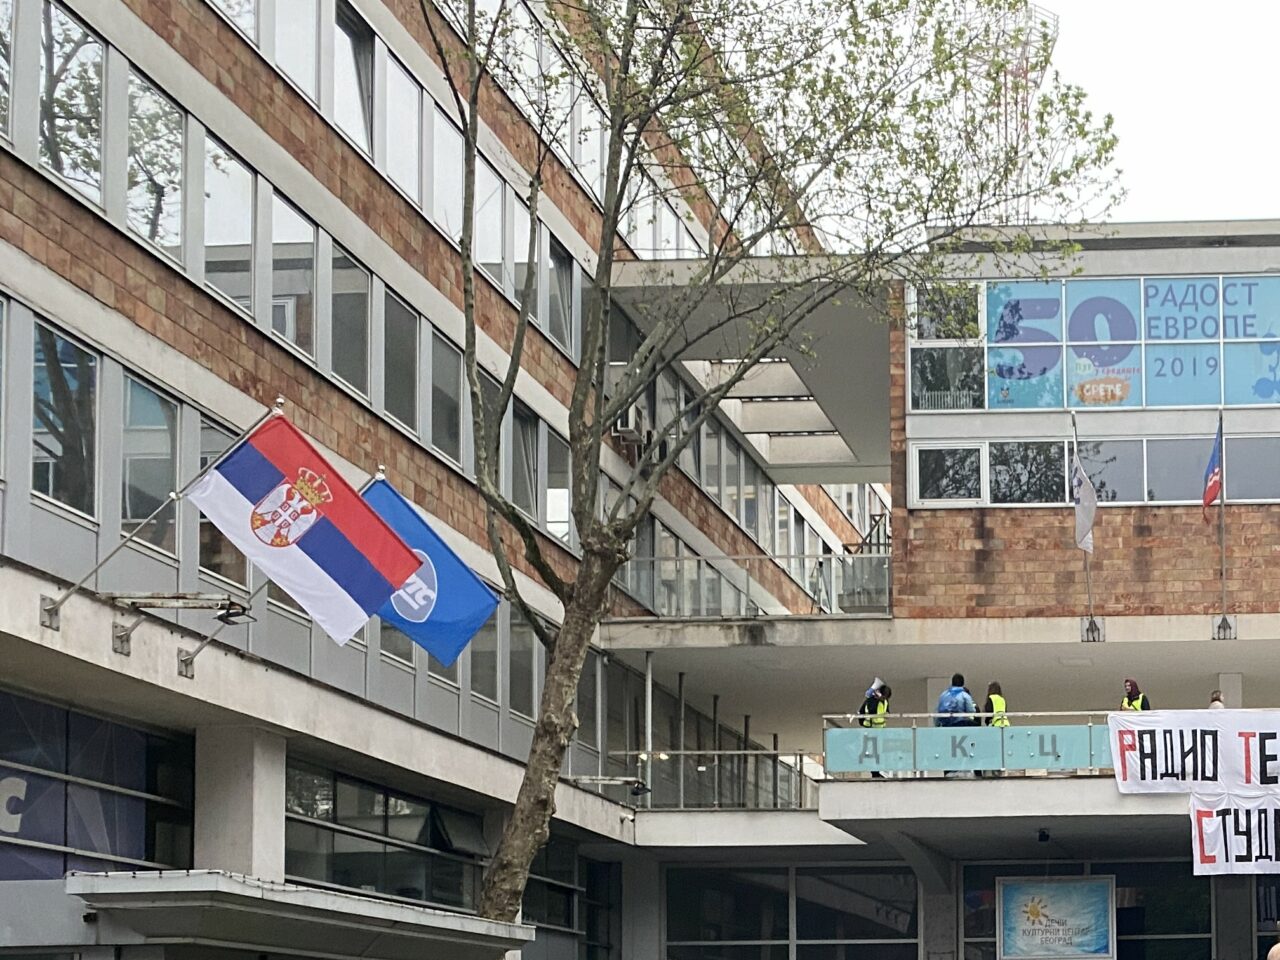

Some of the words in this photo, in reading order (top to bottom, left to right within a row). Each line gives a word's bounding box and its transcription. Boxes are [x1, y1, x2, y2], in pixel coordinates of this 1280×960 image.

[1144, 282, 1259, 312] РАДОСТ
[994, 297, 1138, 381] 50
[1147, 314, 1257, 340] ЕВРОПЕ
[1154, 356, 1218, 377] 2019
[1117, 729, 1218, 782] РАДИО
